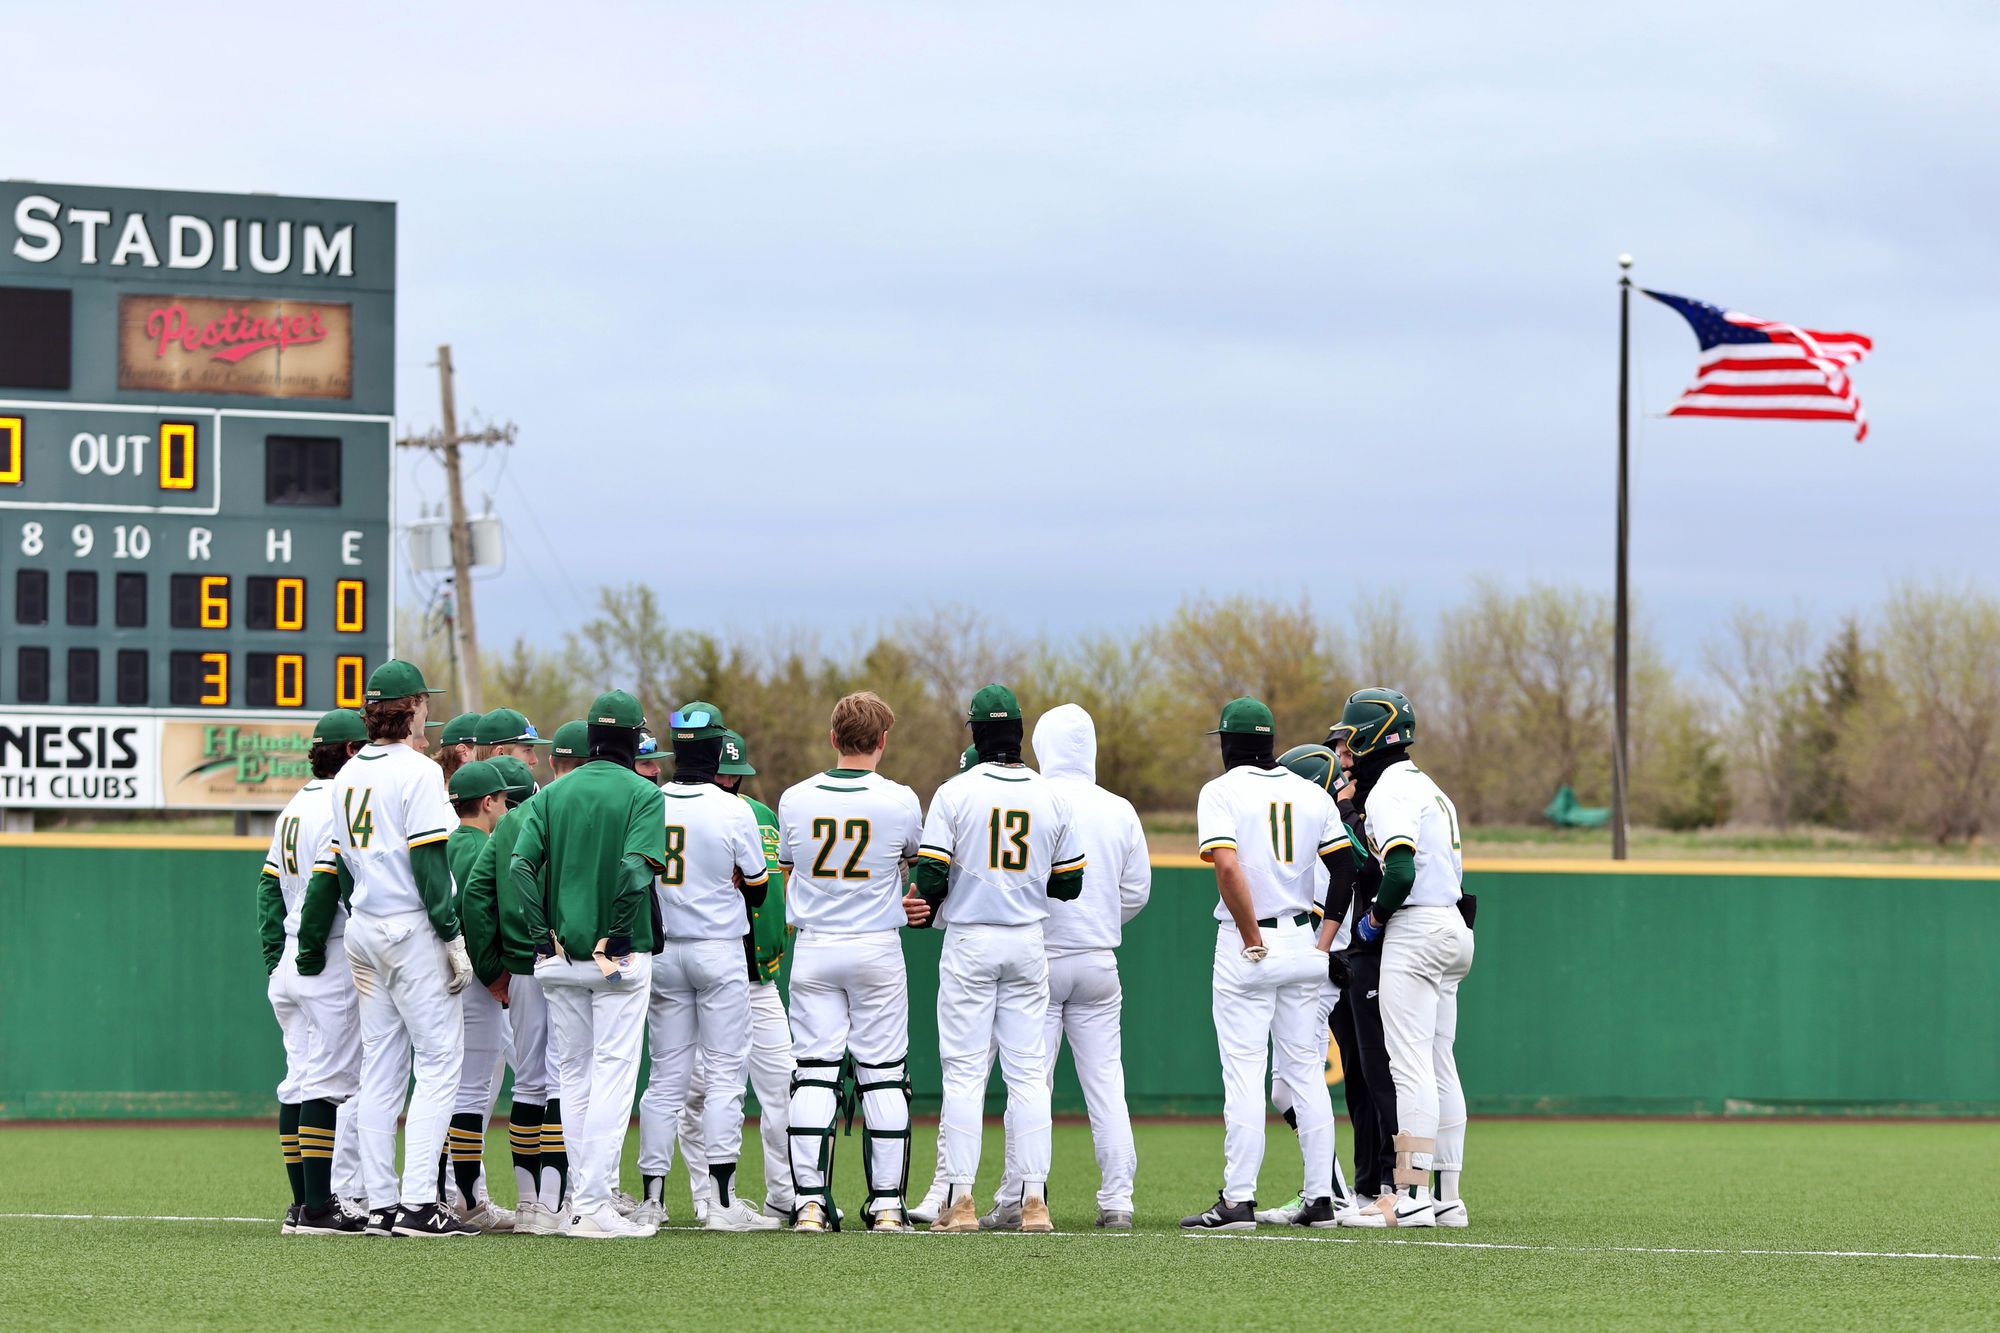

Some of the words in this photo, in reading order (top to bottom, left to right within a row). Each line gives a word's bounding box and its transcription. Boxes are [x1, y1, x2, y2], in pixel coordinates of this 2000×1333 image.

[69, 432, 151, 476] OUT
[160, 424, 194, 489] 0
[21, 521, 44, 556] 8
[71, 524, 94, 558] 9
[113, 525, 151, 559] 10
[188, 527, 212, 560] R
[266, 529, 292, 562] H
[342, 531, 363, 565] E
[201, 576, 228, 628] 6
[276, 578, 303, 630] 0
[336, 580, 363, 632] 0
[201, 653, 227, 705] 3
[276, 655, 303, 706] 0
[336, 656, 363, 708] 0
[1404, 728, 1411, 739] 2
[50, 775, 138, 798] CLUBS
[343, 787, 374, 849] 14
[987, 806, 1032, 873] 13
[1268, 801, 1294, 865] 11
[281, 816, 300, 877] 19
[811, 816, 872, 880] 22
[395, 1212, 405, 1223] B
[571, 1215, 582, 1225] B
